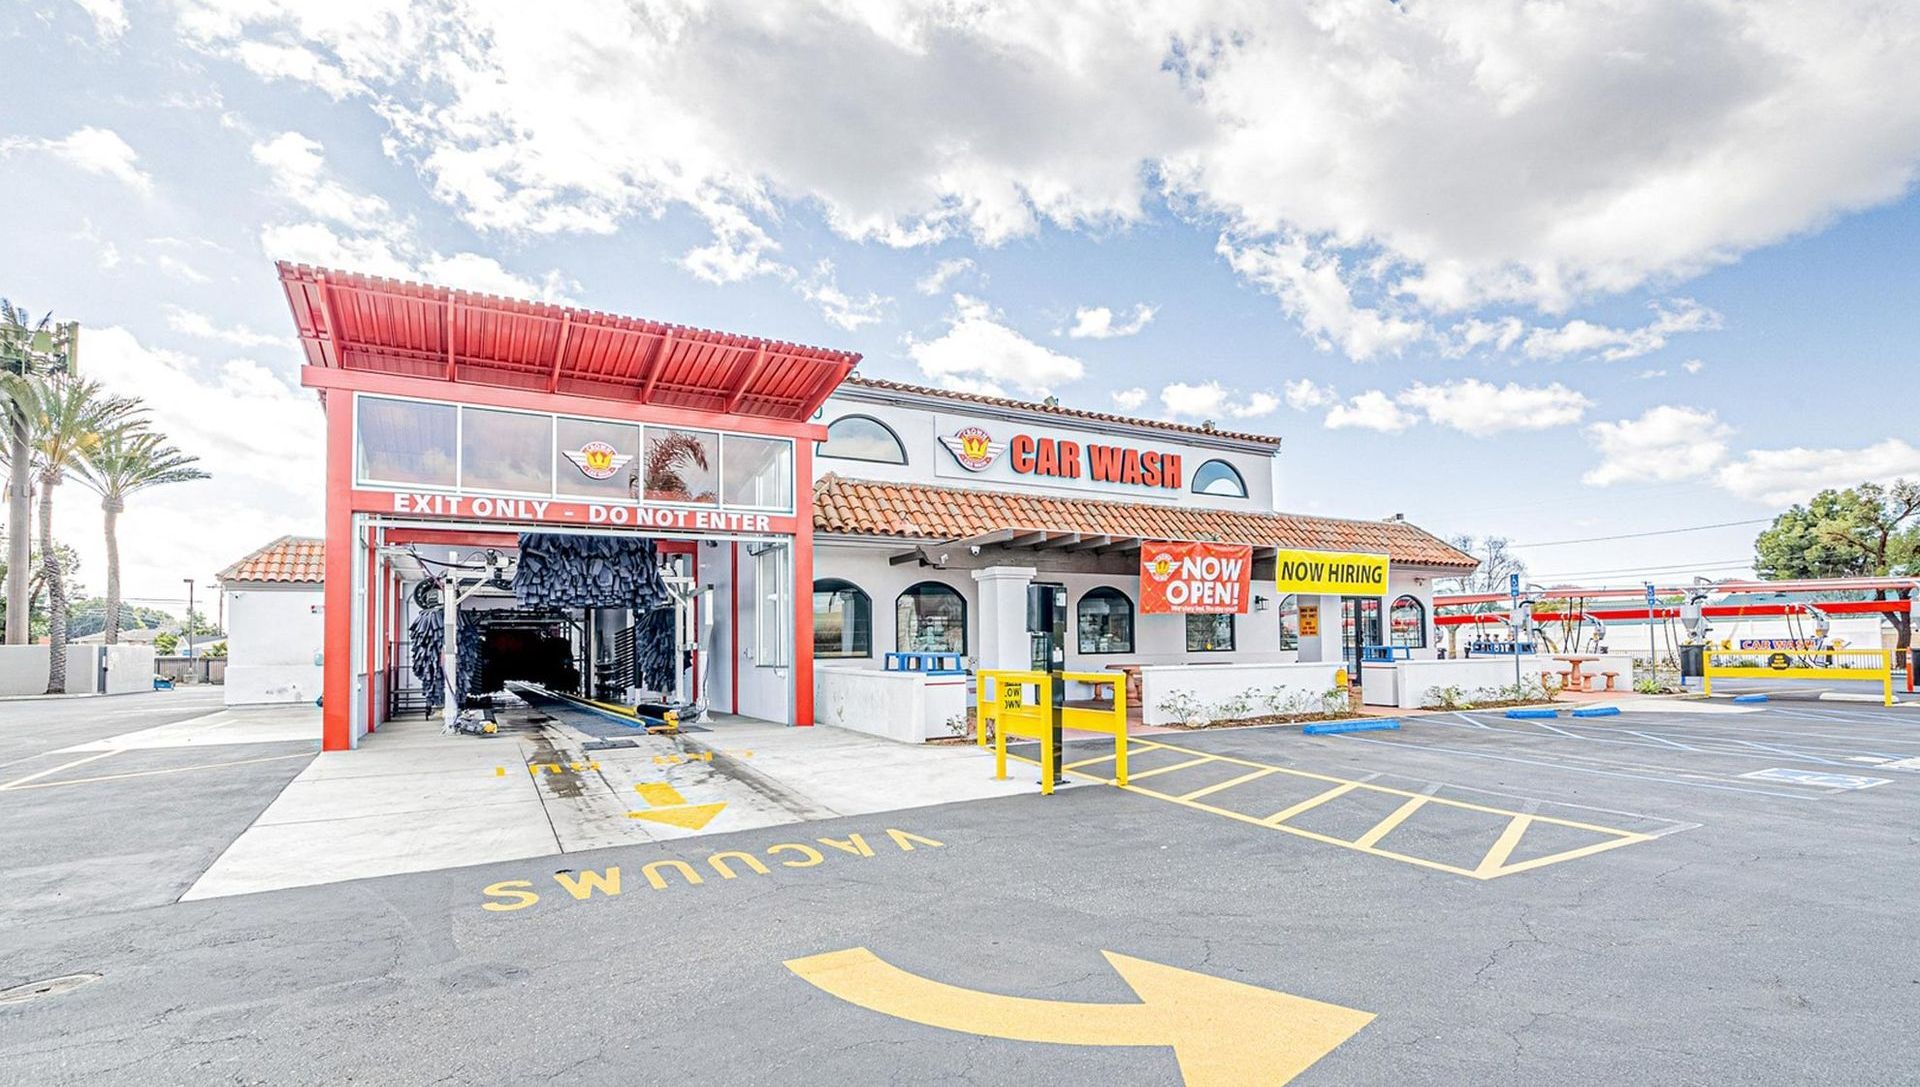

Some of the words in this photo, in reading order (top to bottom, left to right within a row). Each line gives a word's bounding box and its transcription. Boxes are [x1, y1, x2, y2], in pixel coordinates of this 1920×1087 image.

[1011, 434, 1081, 479] CAR
[1087, 443, 1182, 489] WASH
[393, 493, 462, 515] EXIT
[471, 497, 550, 520] ONLY
[589, 504, 629, 525] DO
[636, 507, 689, 528] NOT
[695, 509, 770, 532] ENTER
[1181, 555, 1243, 581] NOW
[1281, 561, 1324, 582] NOW
[1327, 563, 1382, 584] HIRING
[1165, 579, 1240, 605] OPEN!
[481, 828, 944, 912] VACUUMS
